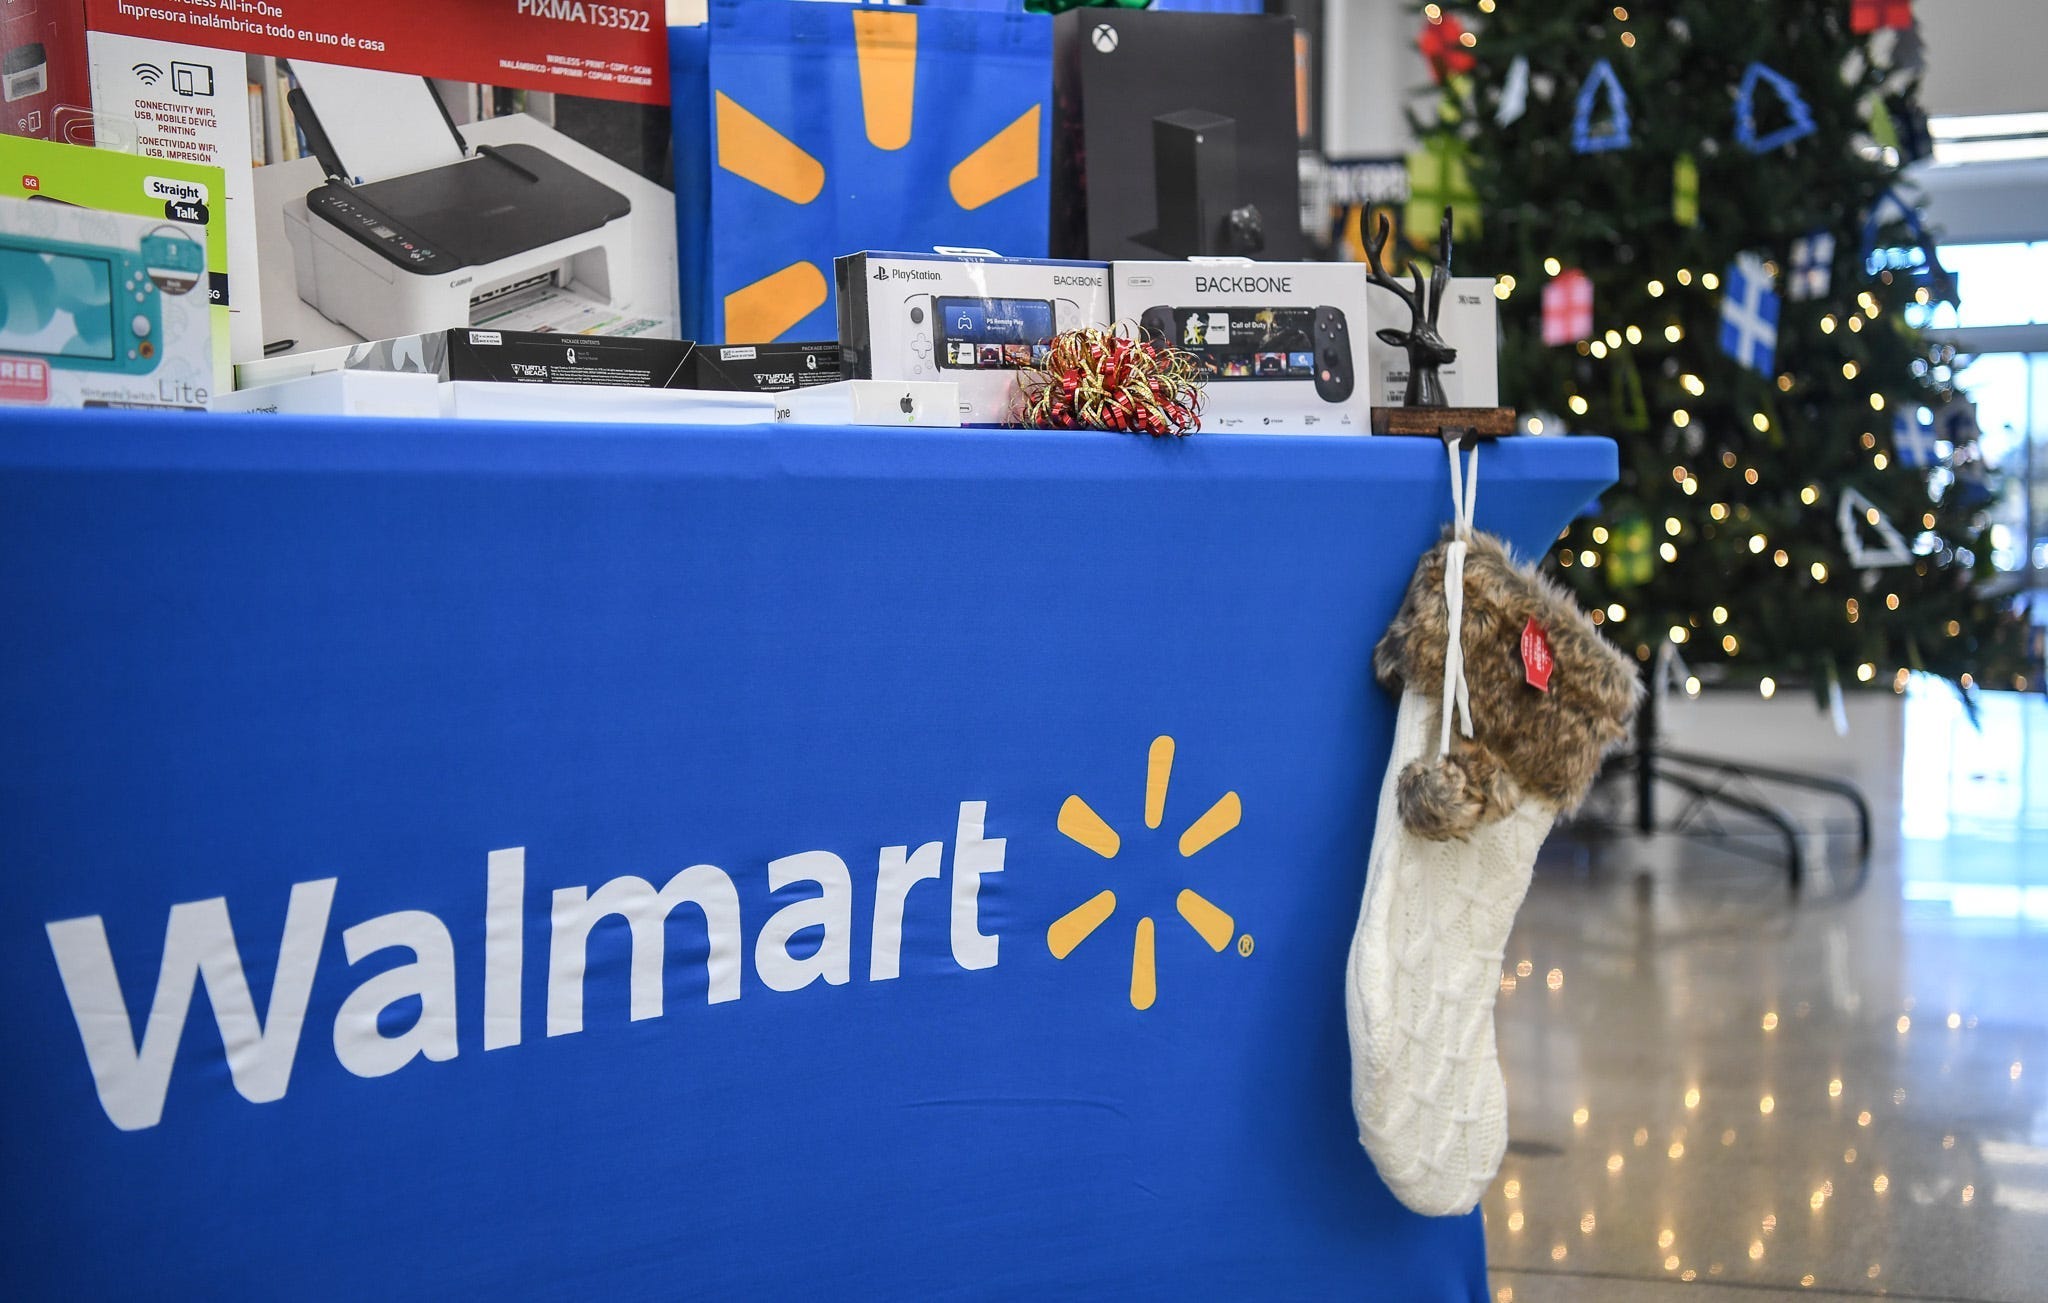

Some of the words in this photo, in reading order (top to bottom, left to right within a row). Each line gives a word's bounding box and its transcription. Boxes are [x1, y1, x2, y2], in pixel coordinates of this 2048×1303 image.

[220, 0, 283, 18] All-in-One
[518, 0, 587, 23] PIXMA
[588, 3, 651, 32] TS3522
[118, 0, 187, 23] Impresora
[189, 11, 263, 35] inalámbrica
[266, 23, 295, 39] todo
[298, 30, 313, 41] en
[316, 32, 339, 45] uno
[341, 33, 356, 47] de
[358, 38, 385, 51] casa
[546, 54, 580, 66] WIRELESS
[134, 99, 194, 115] CONNECTIVITY
[195, 106, 216, 118] WIFI,
[134, 110, 154, 122] USB,
[155, 112, 187, 125] MOBILE
[188, 116, 217, 128] DEVICE
[158, 124, 196, 136] PRINTING
[139, 135, 197, 150] CONECTIVIDAD
[198, 142, 218, 154] WIFI,
[145, 148, 165, 159] USB,
[166, 150, 211, 162] IMPRESIÓN
[25, 177, 37, 187] 5G
[153, 181, 199, 199] Straight
[175, 205, 199, 220] Talk
[892, 268, 941, 283] PlayStation
[1053, 275, 1103, 287] BACKBONE
[1196, 276, 1293, 293] BACKBONE
[0, 361, 43, 380] REE
[520, 364, 546, 372] TURTLE
[159, 378, 209, 405] Lite
[45, 801, 1007, 1132] Walmart
